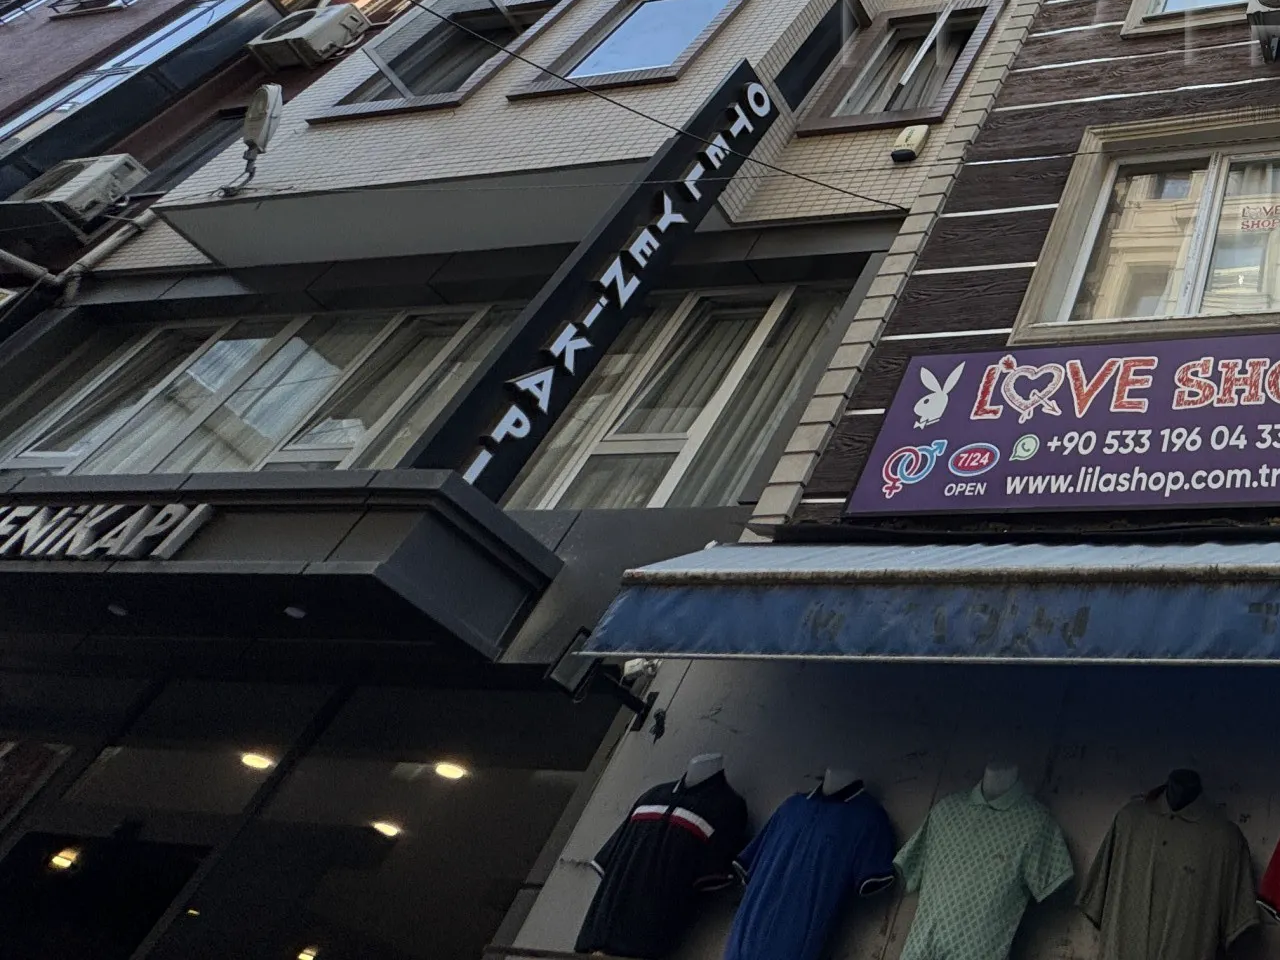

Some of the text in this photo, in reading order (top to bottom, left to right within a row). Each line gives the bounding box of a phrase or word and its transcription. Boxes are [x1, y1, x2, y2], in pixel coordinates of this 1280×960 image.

[683, 81, 772, 201] OTEL
[1240, 218, 1280, 230] SHOP
[1047, 430, 1097, 456] +90
[1103, 429, 1152, 455] 533
[1160, 427, 1202, 452] 196
[1210, 425, 1248, 450] 04
[957, 451, 990, 468] 7/24
[944, 482, 988, 497] OPEN
